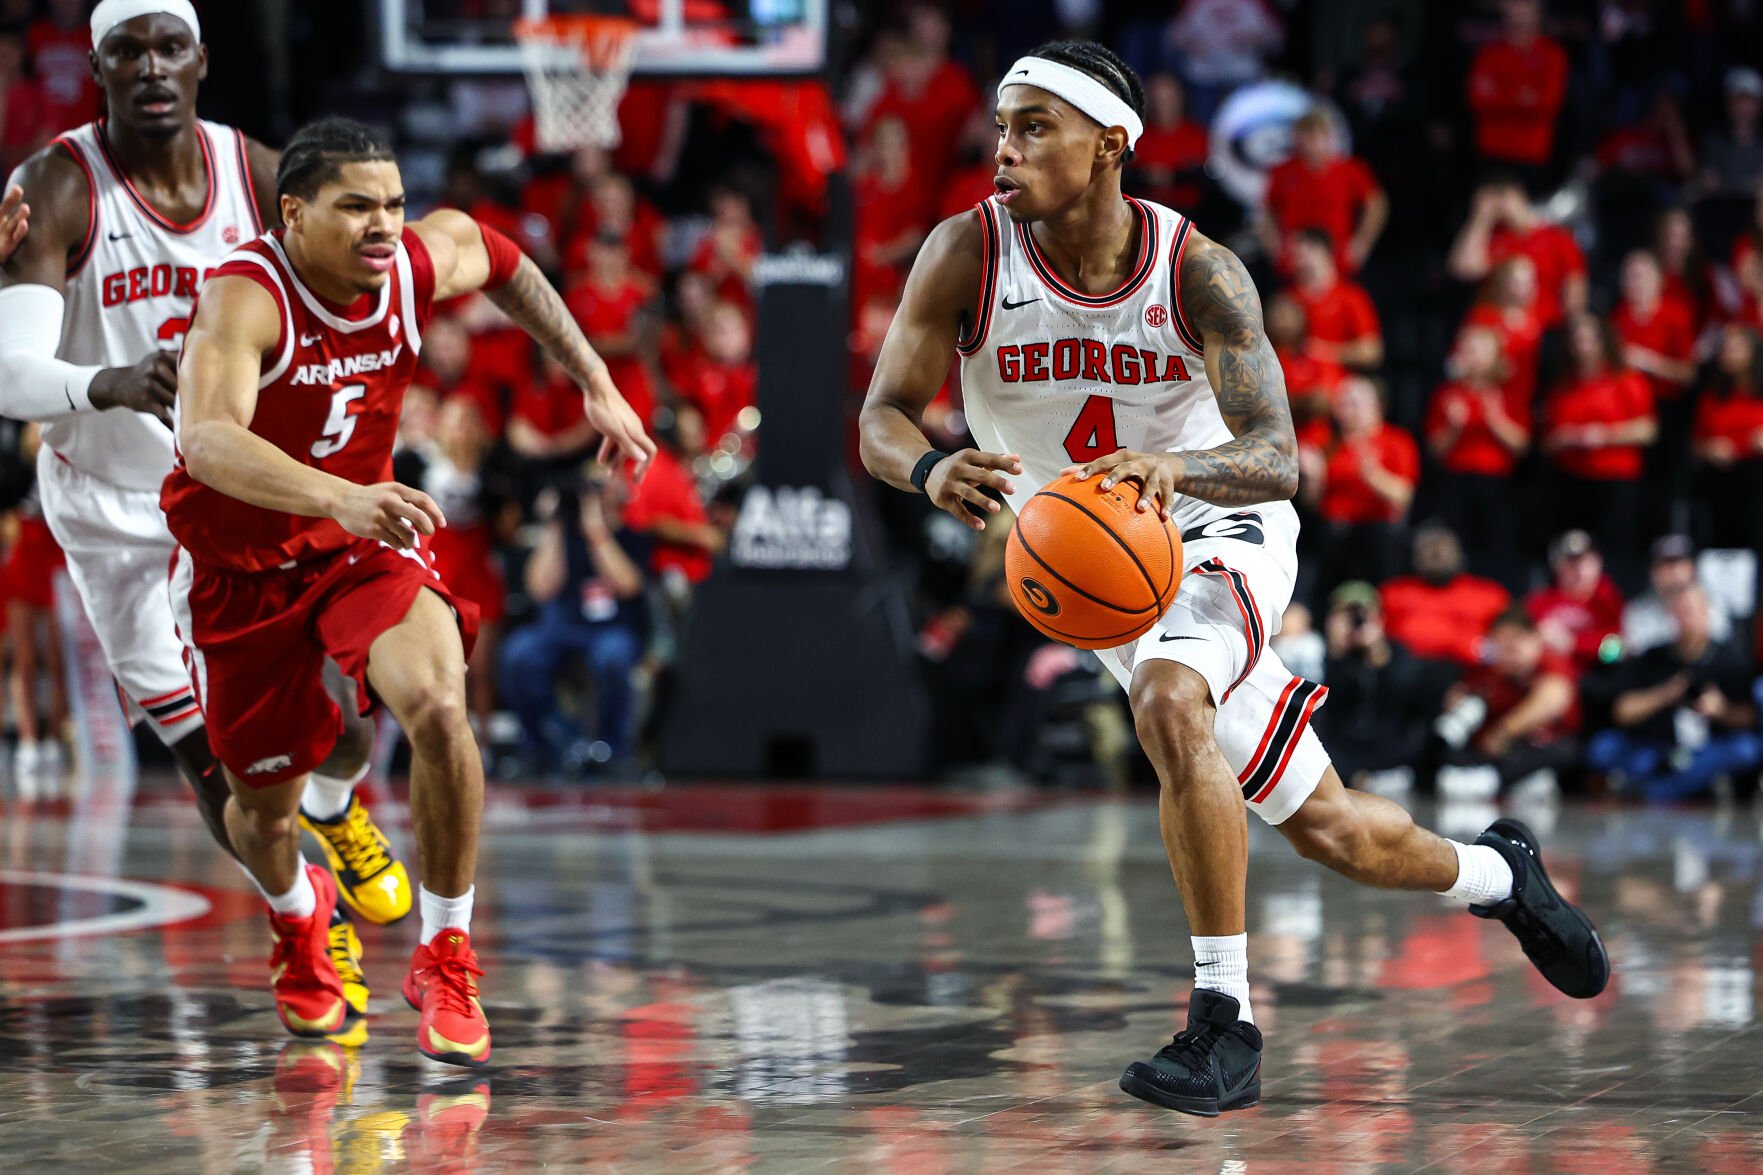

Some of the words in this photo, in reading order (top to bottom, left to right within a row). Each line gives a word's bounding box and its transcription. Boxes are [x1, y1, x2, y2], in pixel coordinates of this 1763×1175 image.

[1147, 306, 1166, 326] SEC
[289, 343, 403, 386] ARANSA
[997, 337, 1192, 386] GEORGIA
[310, 384, 366, 459] 5
[1063, 394, 1127, 464] 4
